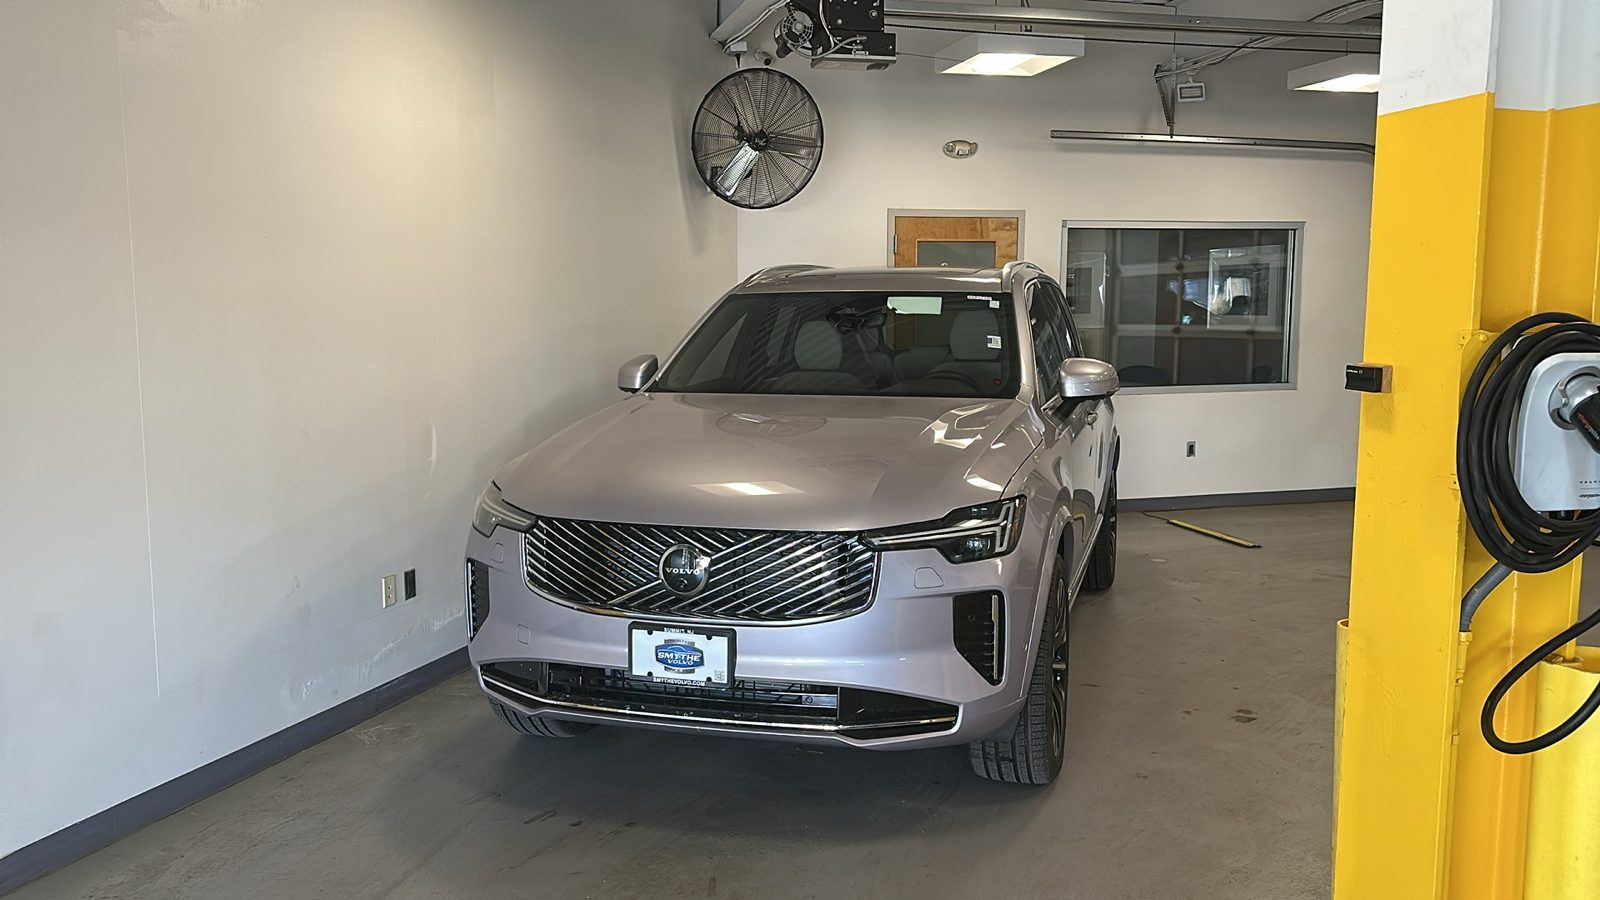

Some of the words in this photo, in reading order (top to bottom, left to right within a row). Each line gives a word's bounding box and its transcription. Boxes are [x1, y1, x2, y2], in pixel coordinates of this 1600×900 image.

[665, 567, 701, 576] VOLVO
[657, 652, 701, 662] SMYTHE
[667, 658, 694, 666] VOLVO
[652, 676, 706, 687] SMYTHEVOLVO.COM
